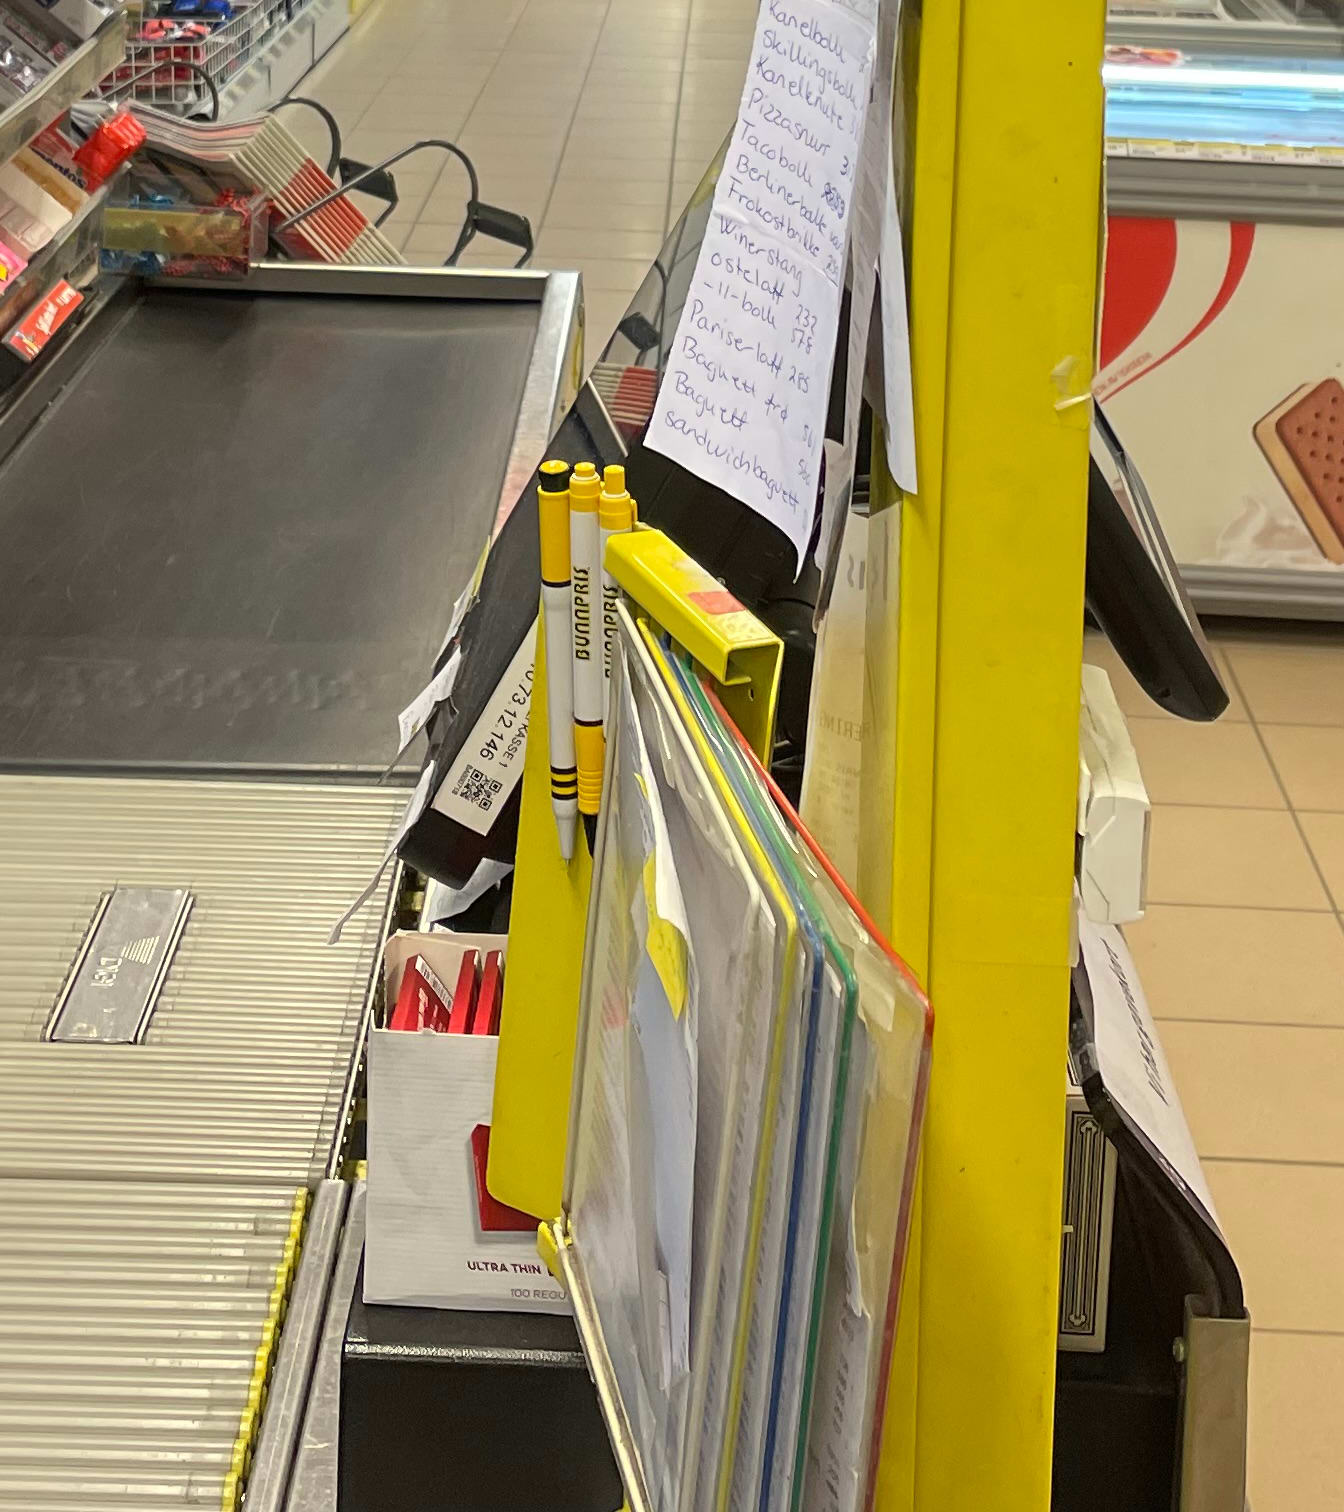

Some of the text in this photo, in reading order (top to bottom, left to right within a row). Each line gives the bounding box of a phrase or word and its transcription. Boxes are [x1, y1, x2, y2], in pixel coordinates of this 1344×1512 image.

[573, 566, 591, 661] BUNNPRIS
[479, 663, 536, 762] 0.73.12.146
[467, 1260, 542, 1275] ULTRA THIN
[510, 1288, 567, 1300] 100 REGU
